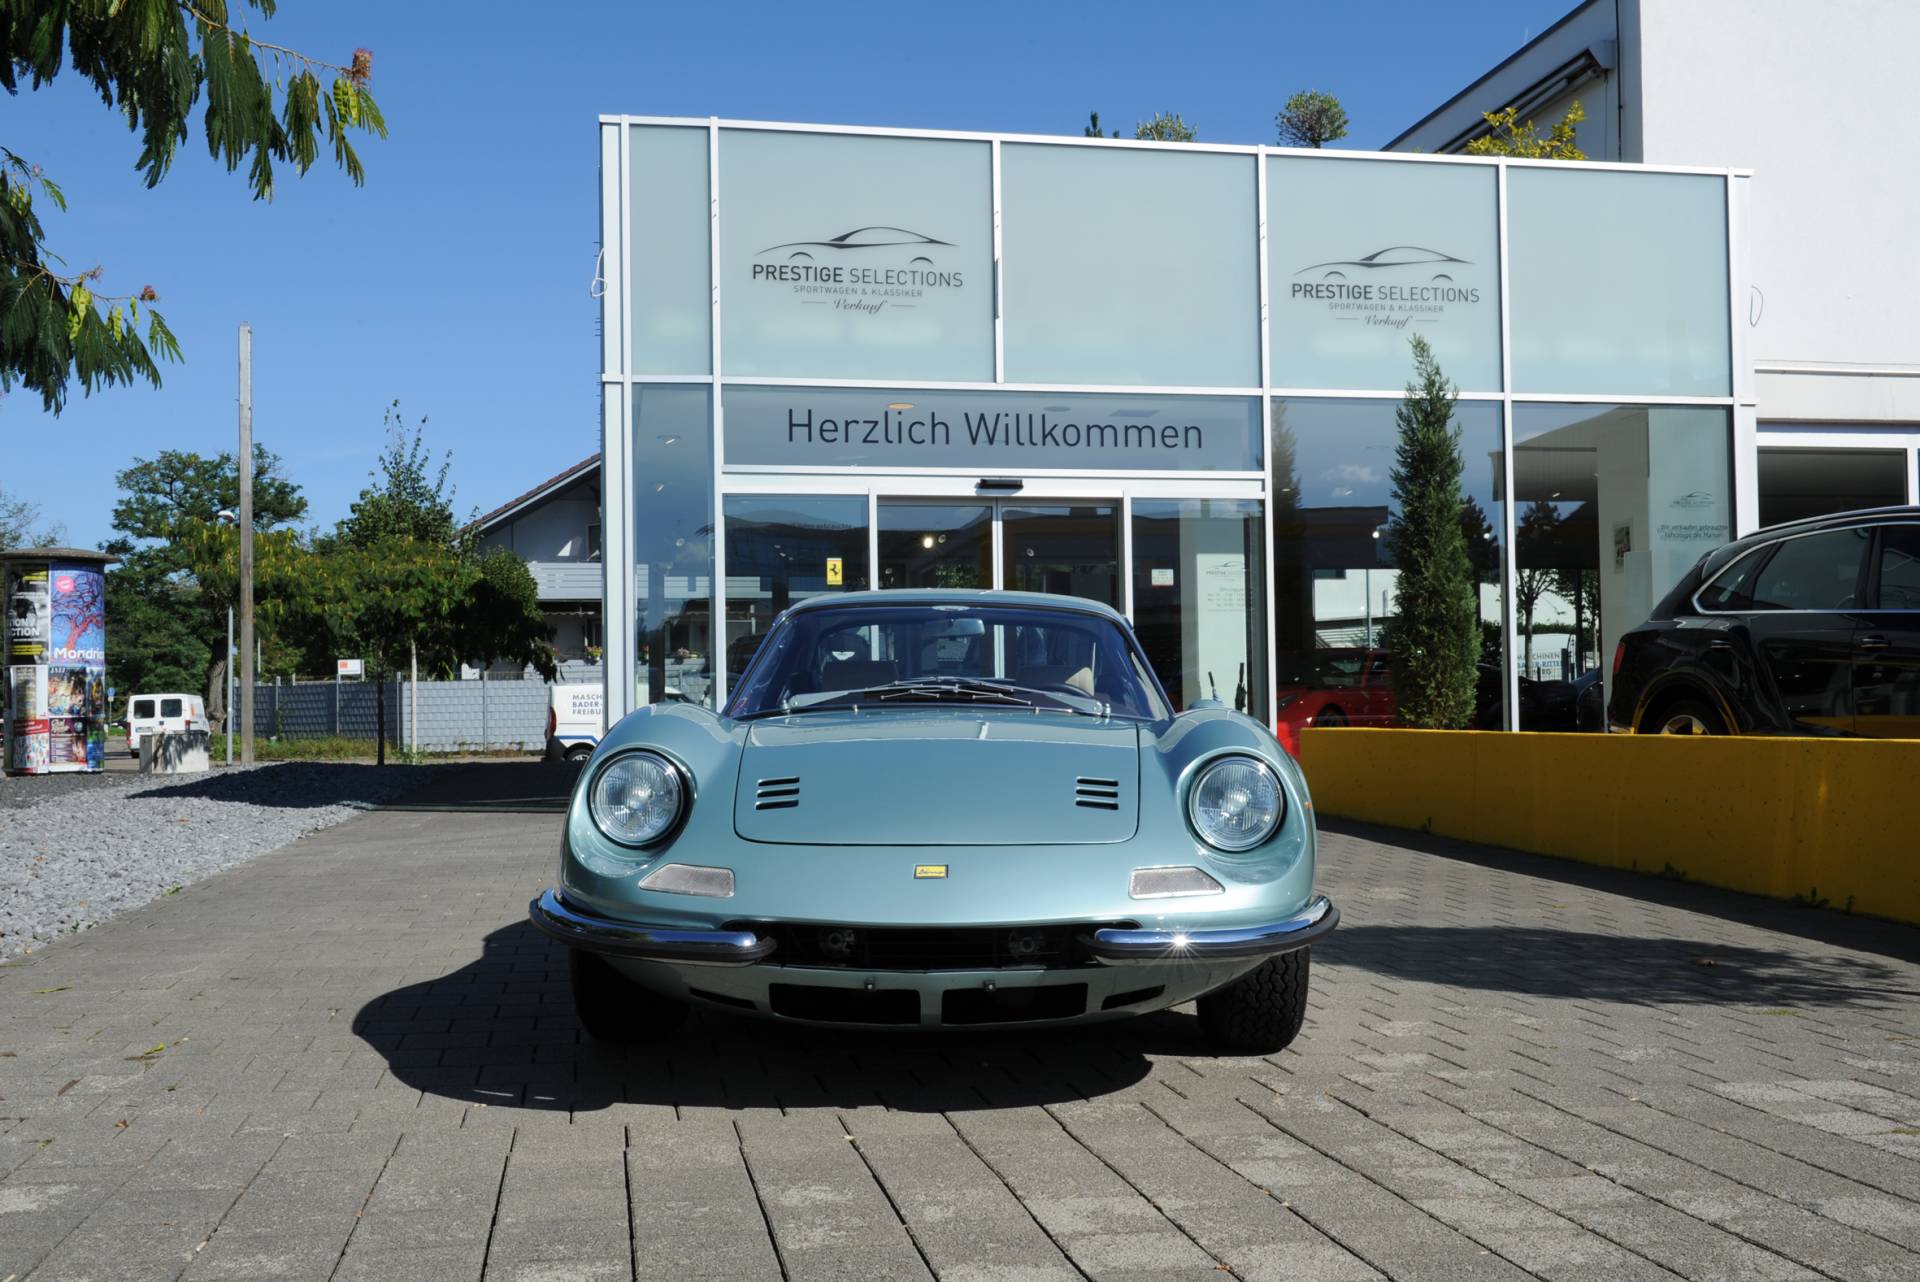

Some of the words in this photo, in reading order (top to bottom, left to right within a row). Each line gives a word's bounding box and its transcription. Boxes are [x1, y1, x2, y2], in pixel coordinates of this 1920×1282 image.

[752, 264, 844, 283] PRESTIGE
[849, 268, 964, 288] SELECTIONS
[793, 284, 858, 296] SPORTWAGEN
[861, 287, 868, 296] &
[871, 288, 923, 298] KLASSIKER
[1292, 283, 1373, 300] PRESTIGE
[1378, 285, 1480, 303] SELECTIONS
[832, 298, 888, 315] Verkauf
[1328, 302, 1386, 312] SPORTWAGEN
[1388, 303, 1395, 312] &
[1398, 304, 1445, 313] KLASSIKER
[1363, 314, 1414, 329] Verkauf
[787, 408, 951, 446] Herzlich
[964, 412, 1203, 449] Willkommen
